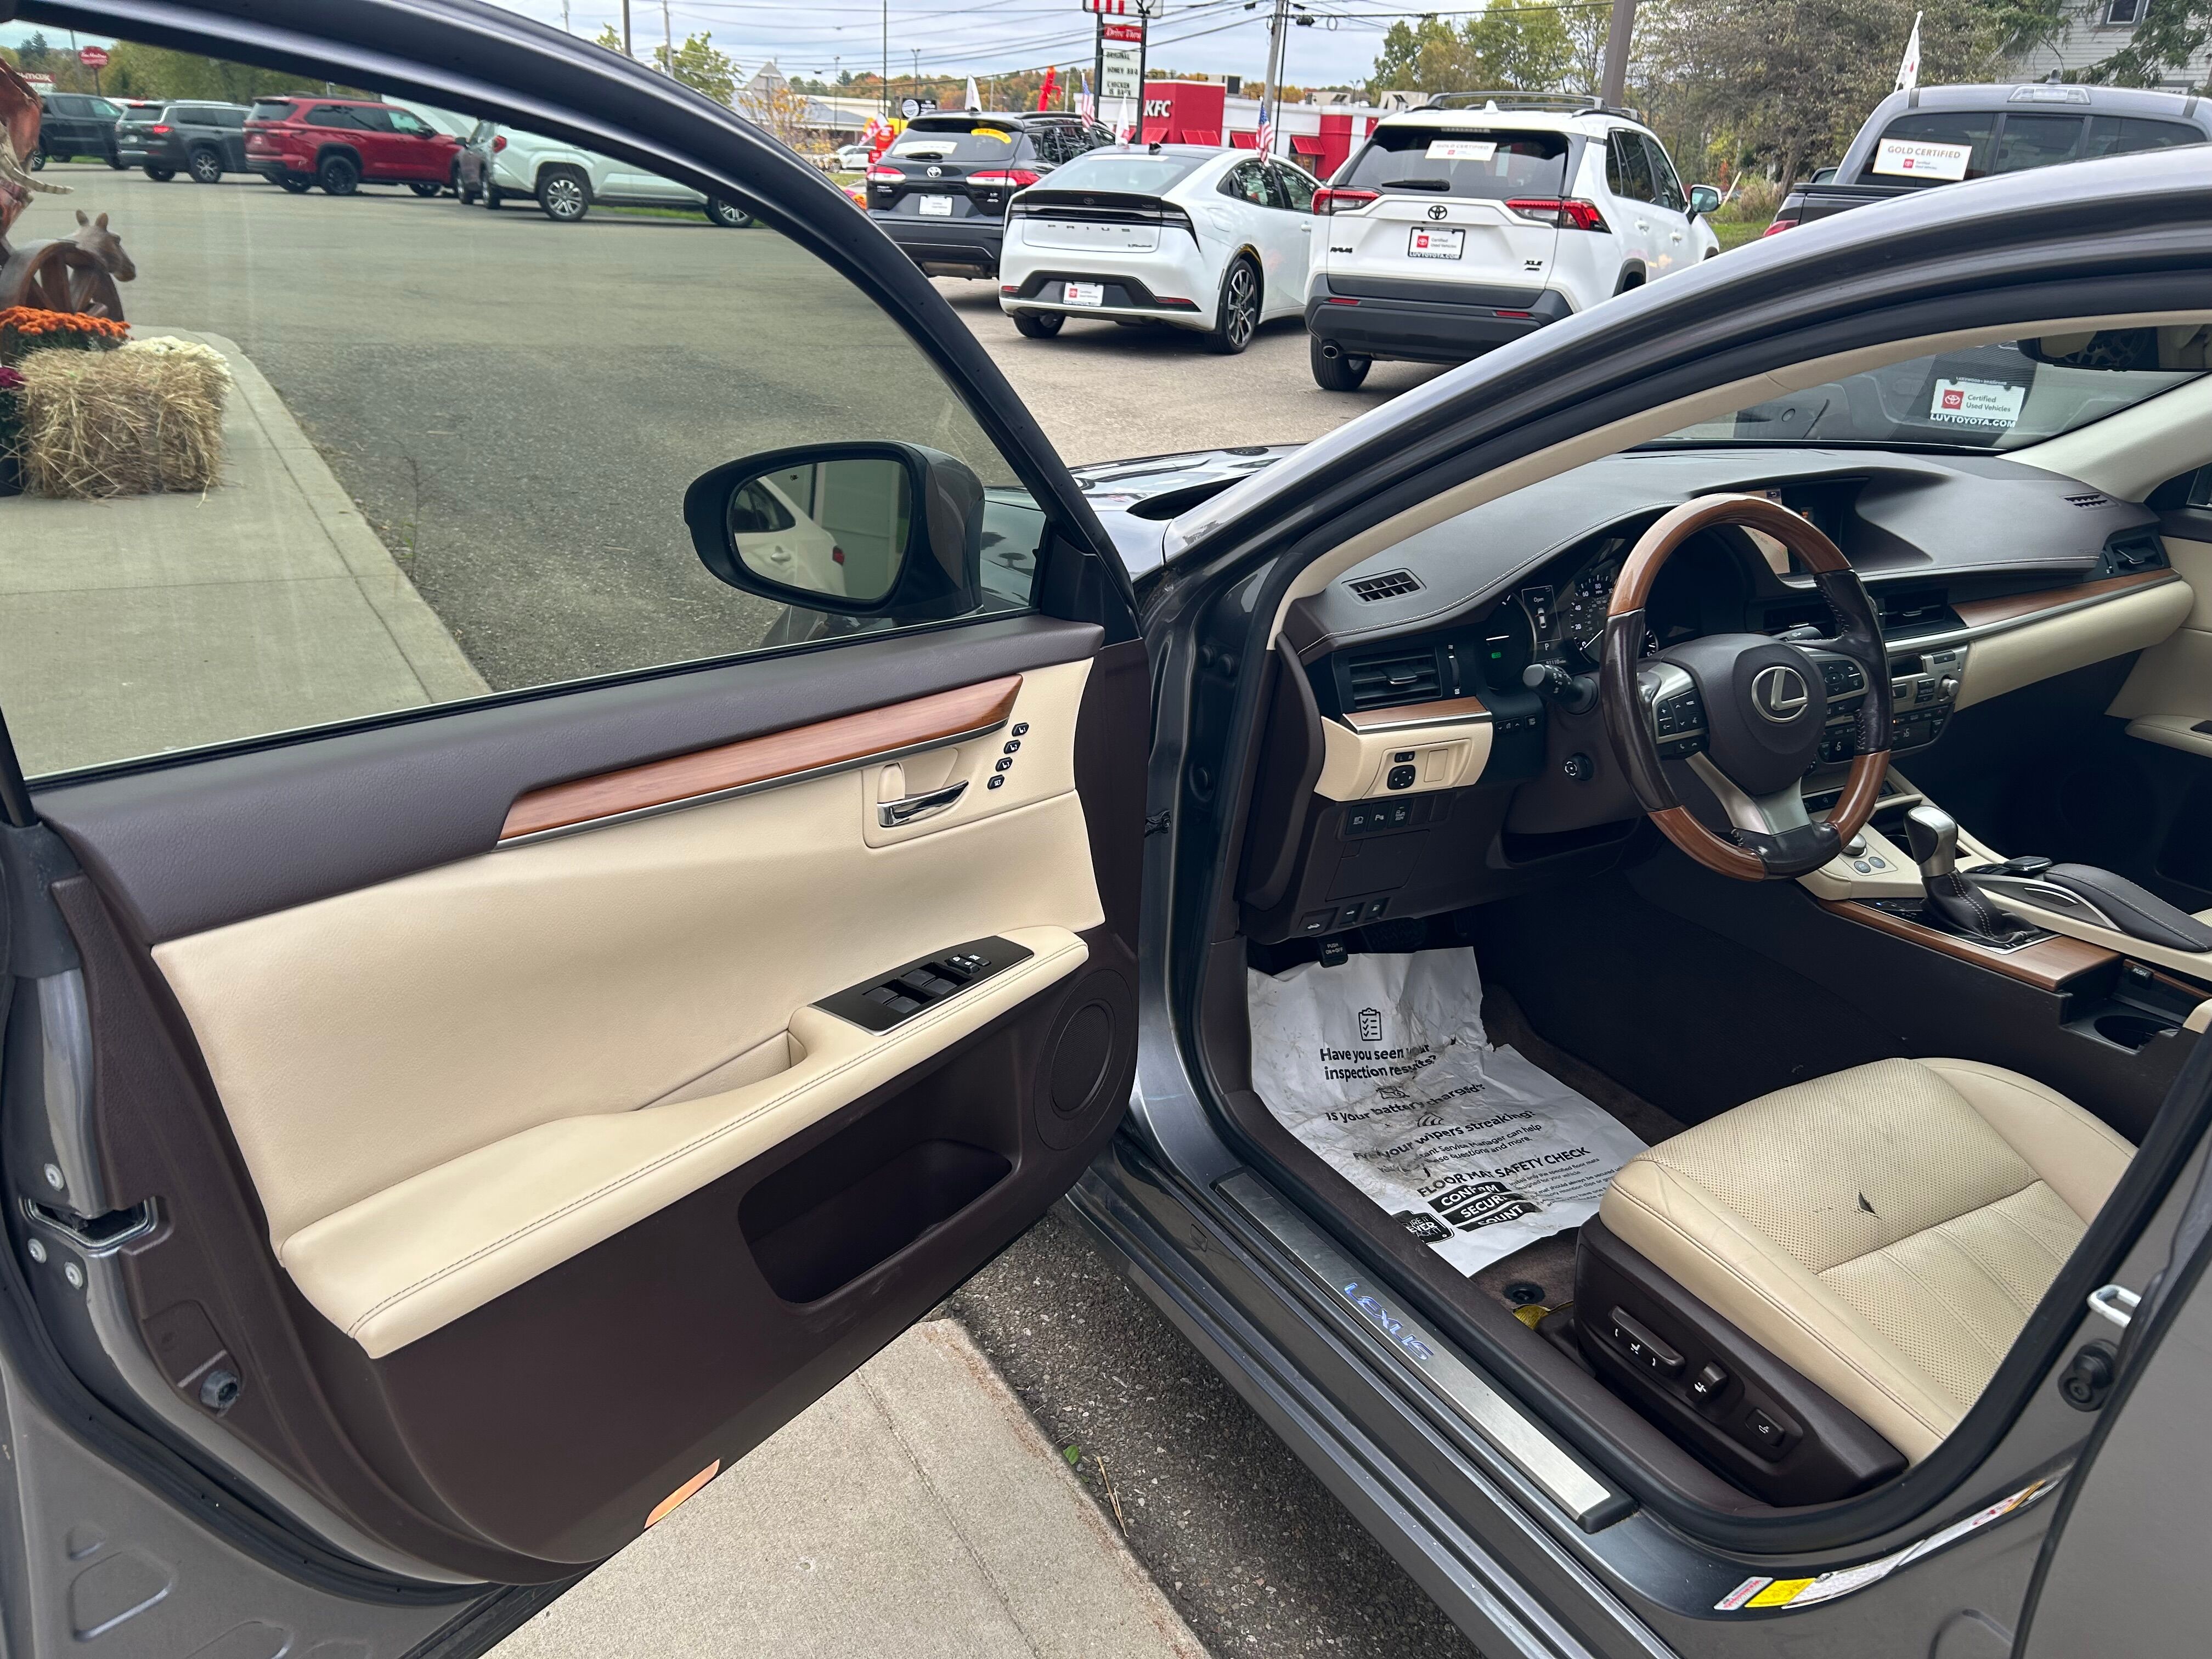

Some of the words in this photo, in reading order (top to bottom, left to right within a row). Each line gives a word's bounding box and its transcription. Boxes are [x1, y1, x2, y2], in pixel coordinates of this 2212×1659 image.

[1143, 99, 1172, 117] KFC
[1888, 145, 1913, 154] GOLD
[1915, 148, 1960, 159] CERTIFIED
[1967, 394, 1996, 403] Certified
[1984, 404, 2011, 413] Vehicles
[1930, 413, 2016, 428] LUVTOYOTA.COM
[2133, 968, 2147, 976] PUSH
[1319, 1048, 1352, 1062] Have
[1353, 1049, 1372, 1063] you
[1374, 1048, 1404, 1060] seen
[1324, 1066, 1387, 1082] inspection
[1389, 1054, 1437, 1076] results?
[1326, 1112, 1339, 1121] Is
[1341, 1111, 1370, 1124] your
[1370, 1101, 1425, 1116] battery
[1426, 1083, 1486, 1106] charged?
[1415, 1122, 1464, 1145] wipers
[1465, 1110, 1536, 1132] streaking?
[1439, 1143, 1469, 1153] Service
[1470, 1136, 1505, 1148] Manager
[1506, 1130, 1523, 1139] can
[1523, 1124, 1542, 1133] help
[1449, 1147, 1490, 1160] questions
[1490, 1143, 1508, 1153] and
[1416, 1172, 1468, 1198] FLOOR
[1497, 1157, 1544, 1178] SAFETY
[1543, 1147, 1592, 1165] CHECK
[1509, 1178, 1527, 1186] Install
[1548, 1166, 1573, 1175] specified
[1550, 1181, 1568, 1191] should
[1594, 1169, 1615, 1178] secured
[1441, 1184, 1499, 1206] CONFRM
[1460, 1194, 1508, 1218] SECUR
[1345, 1282, 1435, 1360] LEXUS
